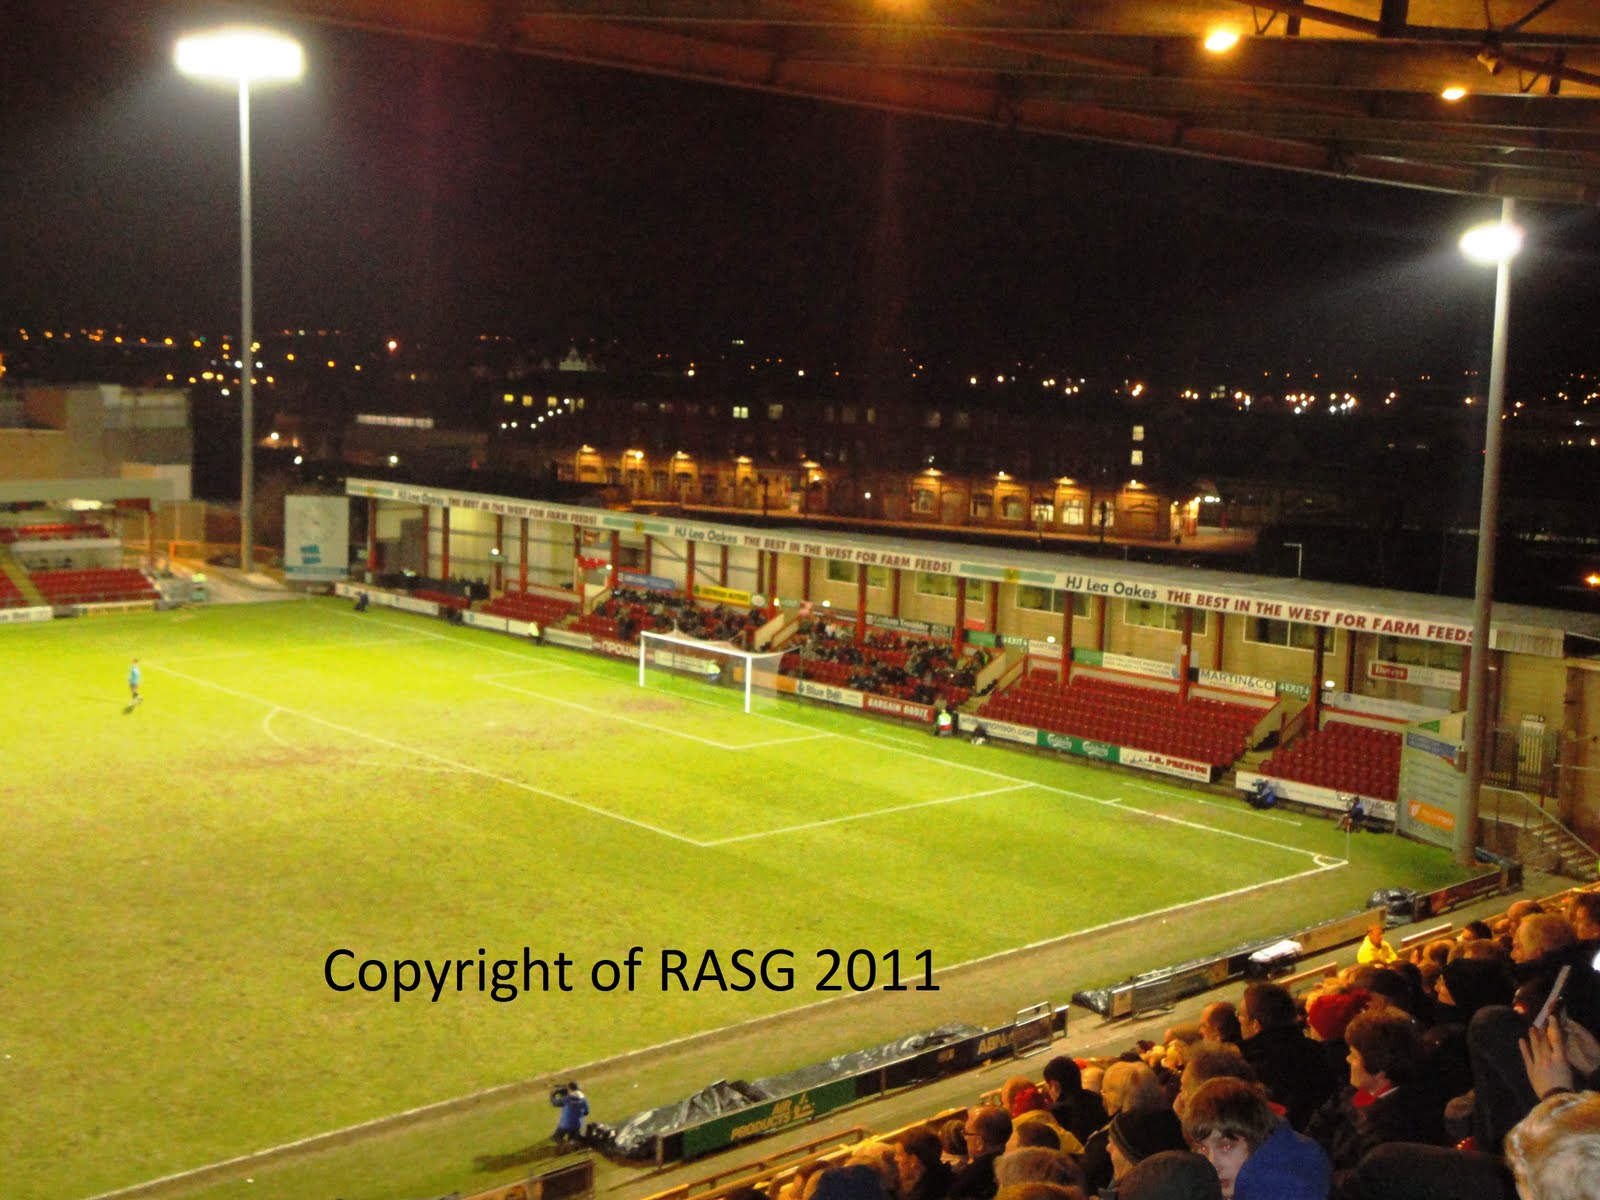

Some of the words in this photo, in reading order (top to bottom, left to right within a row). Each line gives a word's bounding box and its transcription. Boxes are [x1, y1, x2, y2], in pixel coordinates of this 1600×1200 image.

[744, 535, 760, 547] THE
[764, 538, 787, 550] BEST
[789, 541, 800, 552] IN
[804, 544, 820, 555] THE
[825, 546, 853, 560] WEST
[856, 551, 877, 563] FOR
[881, 554, 910, 568] FARM
[914, 557, 952, 573] FEEDS!
[1066, 576, 1082, 591] HJ
[1087, 578, 1108, 593] Lea
[1113, 582, 1157, 599] Oakes
[1167, 590, 1190, 604] THE
[1196, 593, 1230, 609] BEST
[1234, 599, 1251, 612] IN
[1256, 602, 1282, 616] THE
[1288, 606, 1330, 623] WEST
[1335, 613, 1367, 628] FOR
[1372, 618, 1420, 636] FARM
